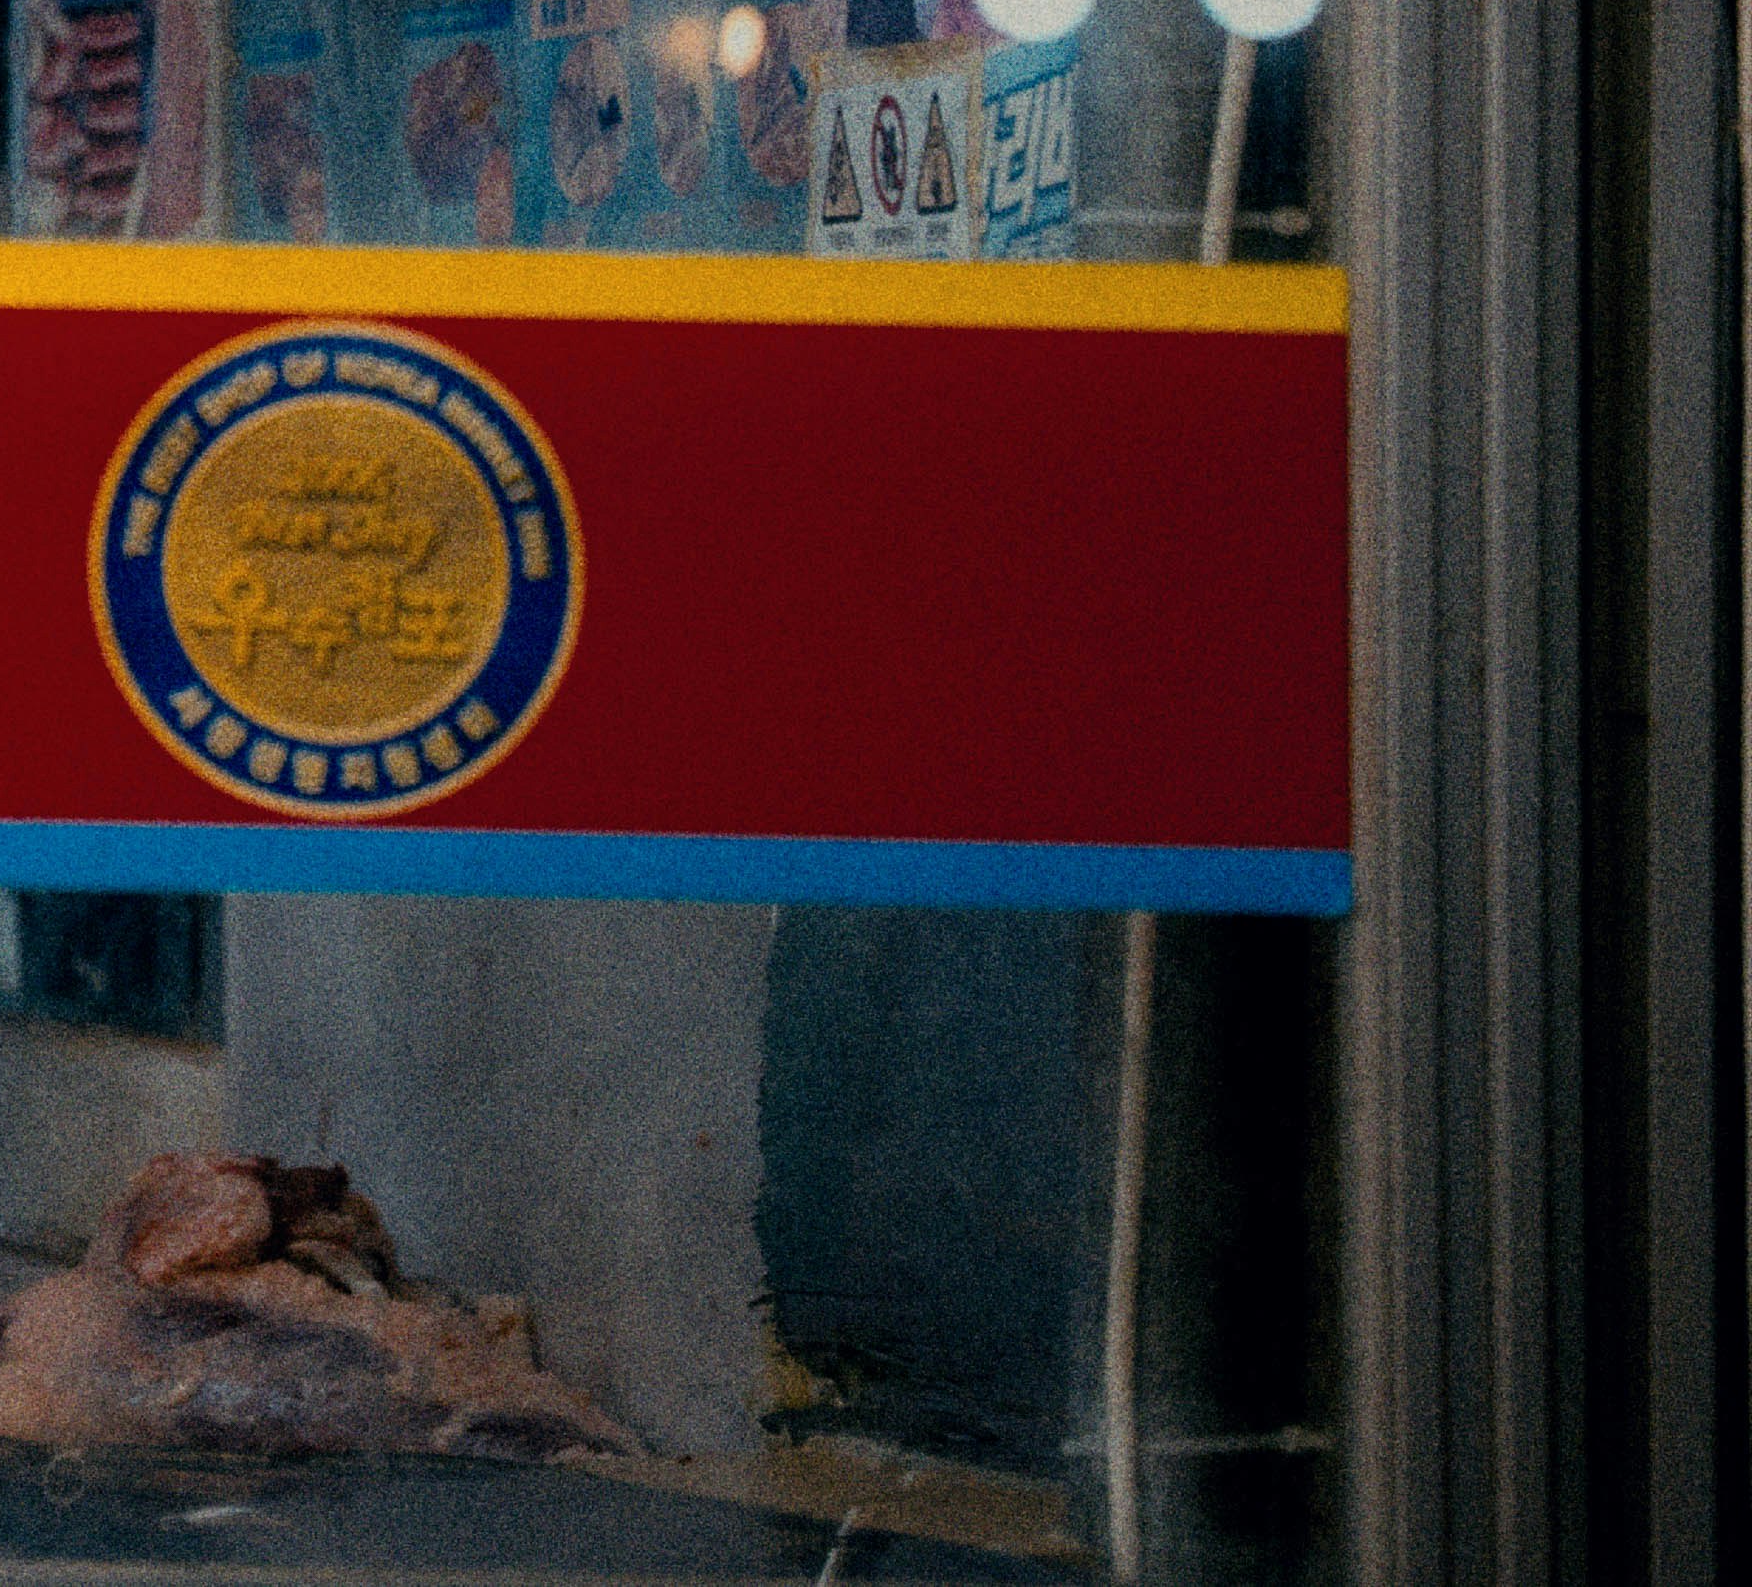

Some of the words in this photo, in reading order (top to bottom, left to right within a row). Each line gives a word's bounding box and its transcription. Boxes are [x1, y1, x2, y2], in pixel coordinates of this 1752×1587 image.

[196, 360, 277, 427] SHOP
[281, 349, 328, 387] OF
[335, 352, 441, 405] KOREA
[185, 562, 467, 672] 우수점포
